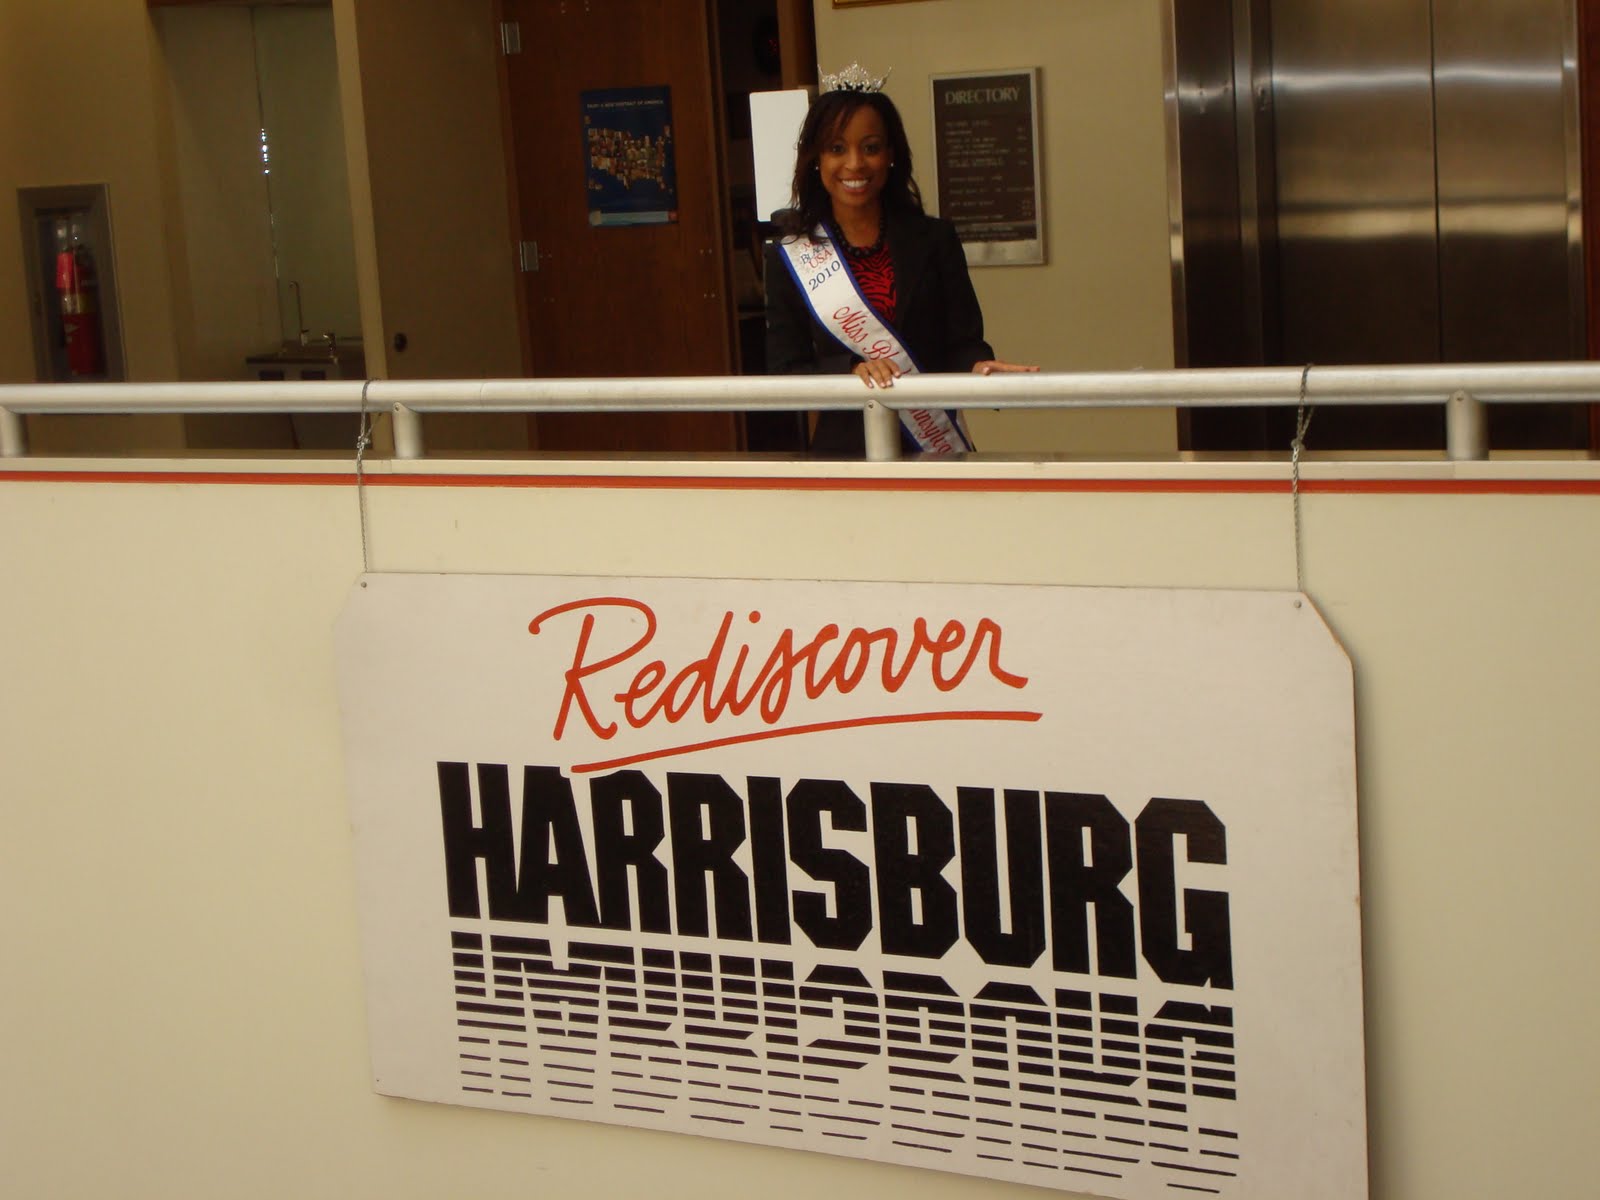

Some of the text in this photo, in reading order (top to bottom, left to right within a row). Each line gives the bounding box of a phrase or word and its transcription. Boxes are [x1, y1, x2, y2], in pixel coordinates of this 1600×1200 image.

[945, 87, 1020, 105] DIRECTORY
[808, 260, 841, 291] 2010
[809, 249, 832, 268] USA
[833, 306, 868, 344] Miss
[529, 597, 1028, 741] Rediscover
[438, 761, 1233, 990] HARRISBURG
